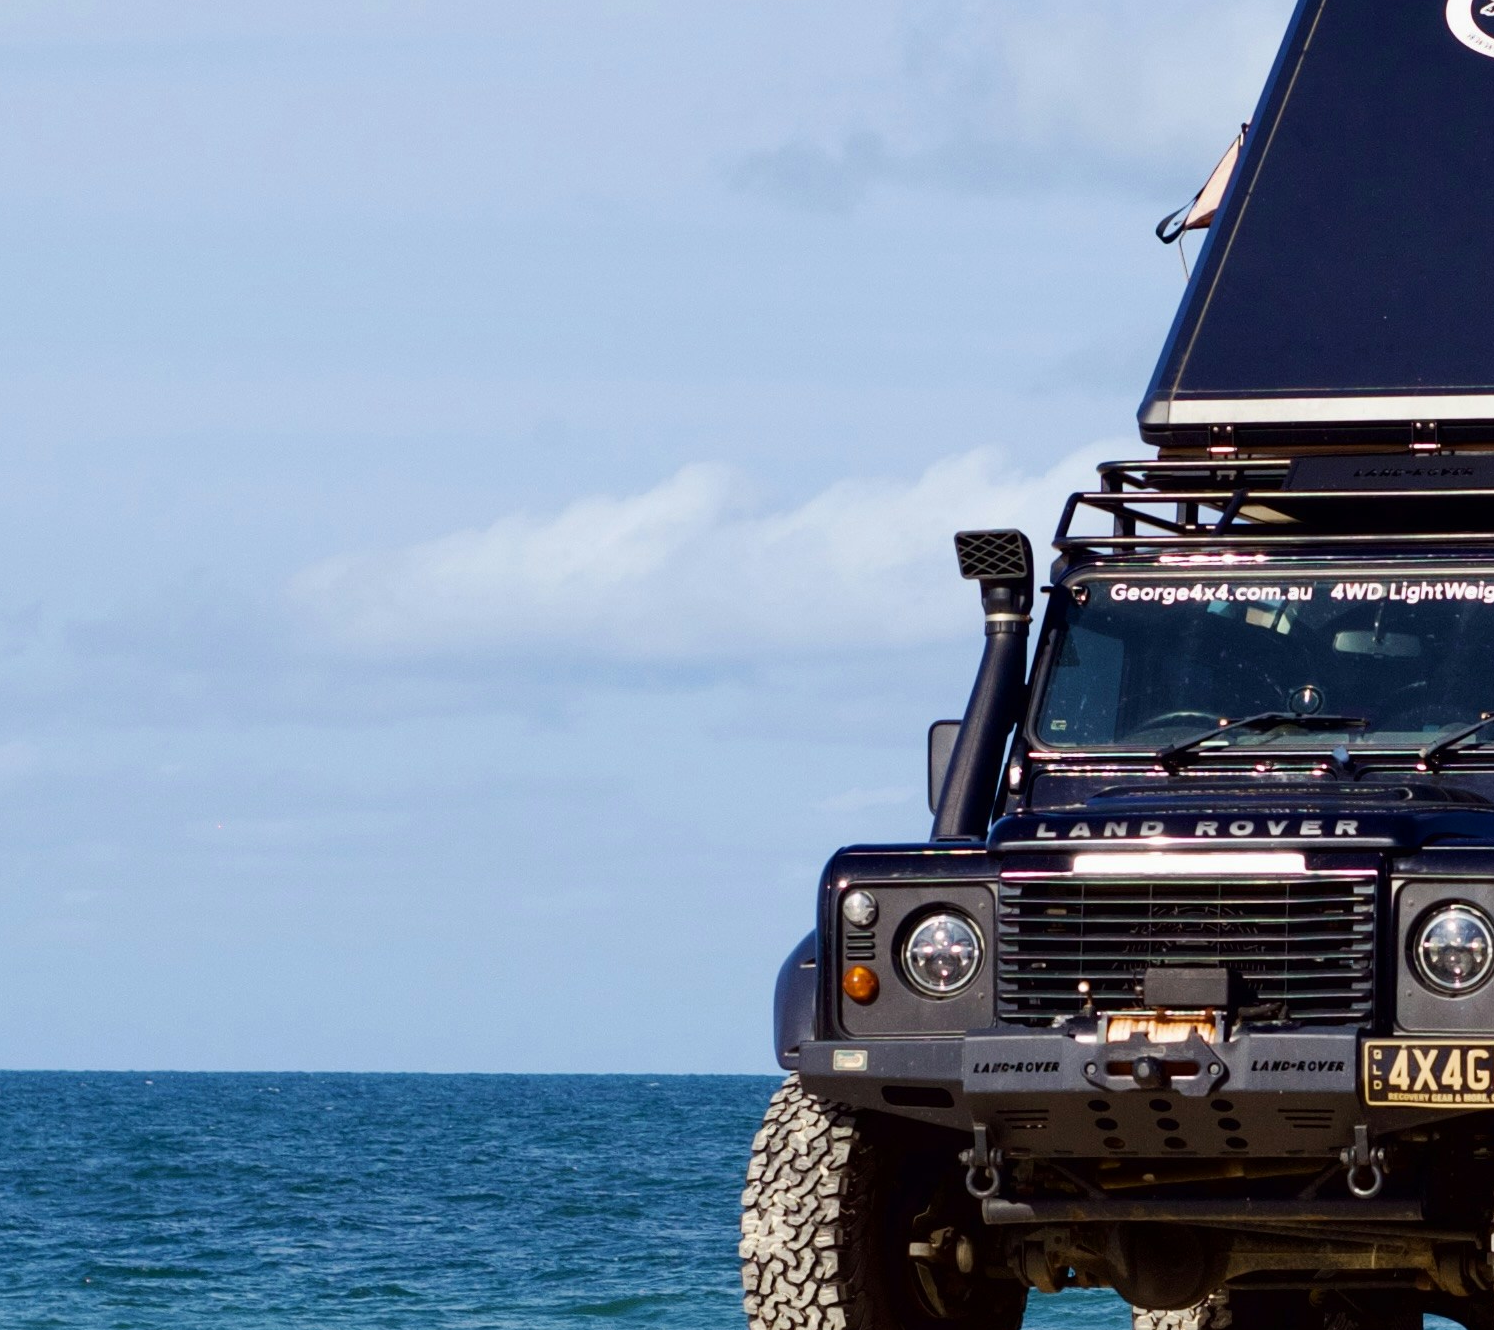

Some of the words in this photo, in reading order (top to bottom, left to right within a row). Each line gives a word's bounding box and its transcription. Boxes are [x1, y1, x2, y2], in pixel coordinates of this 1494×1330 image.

[1110, 583, 1313, 605] George4x4.com.au
[1330, 582, 1383, 600] 4WD
[1036, 820, 1165, 838] LAND
[1195, 819, 1360, 836] ROVER
[1388, 1092, 1429, 1101] RECOVERY
[1431, 1093, 1453, 1102] GEAR
[1455, 1093, 1462, 1102] &
